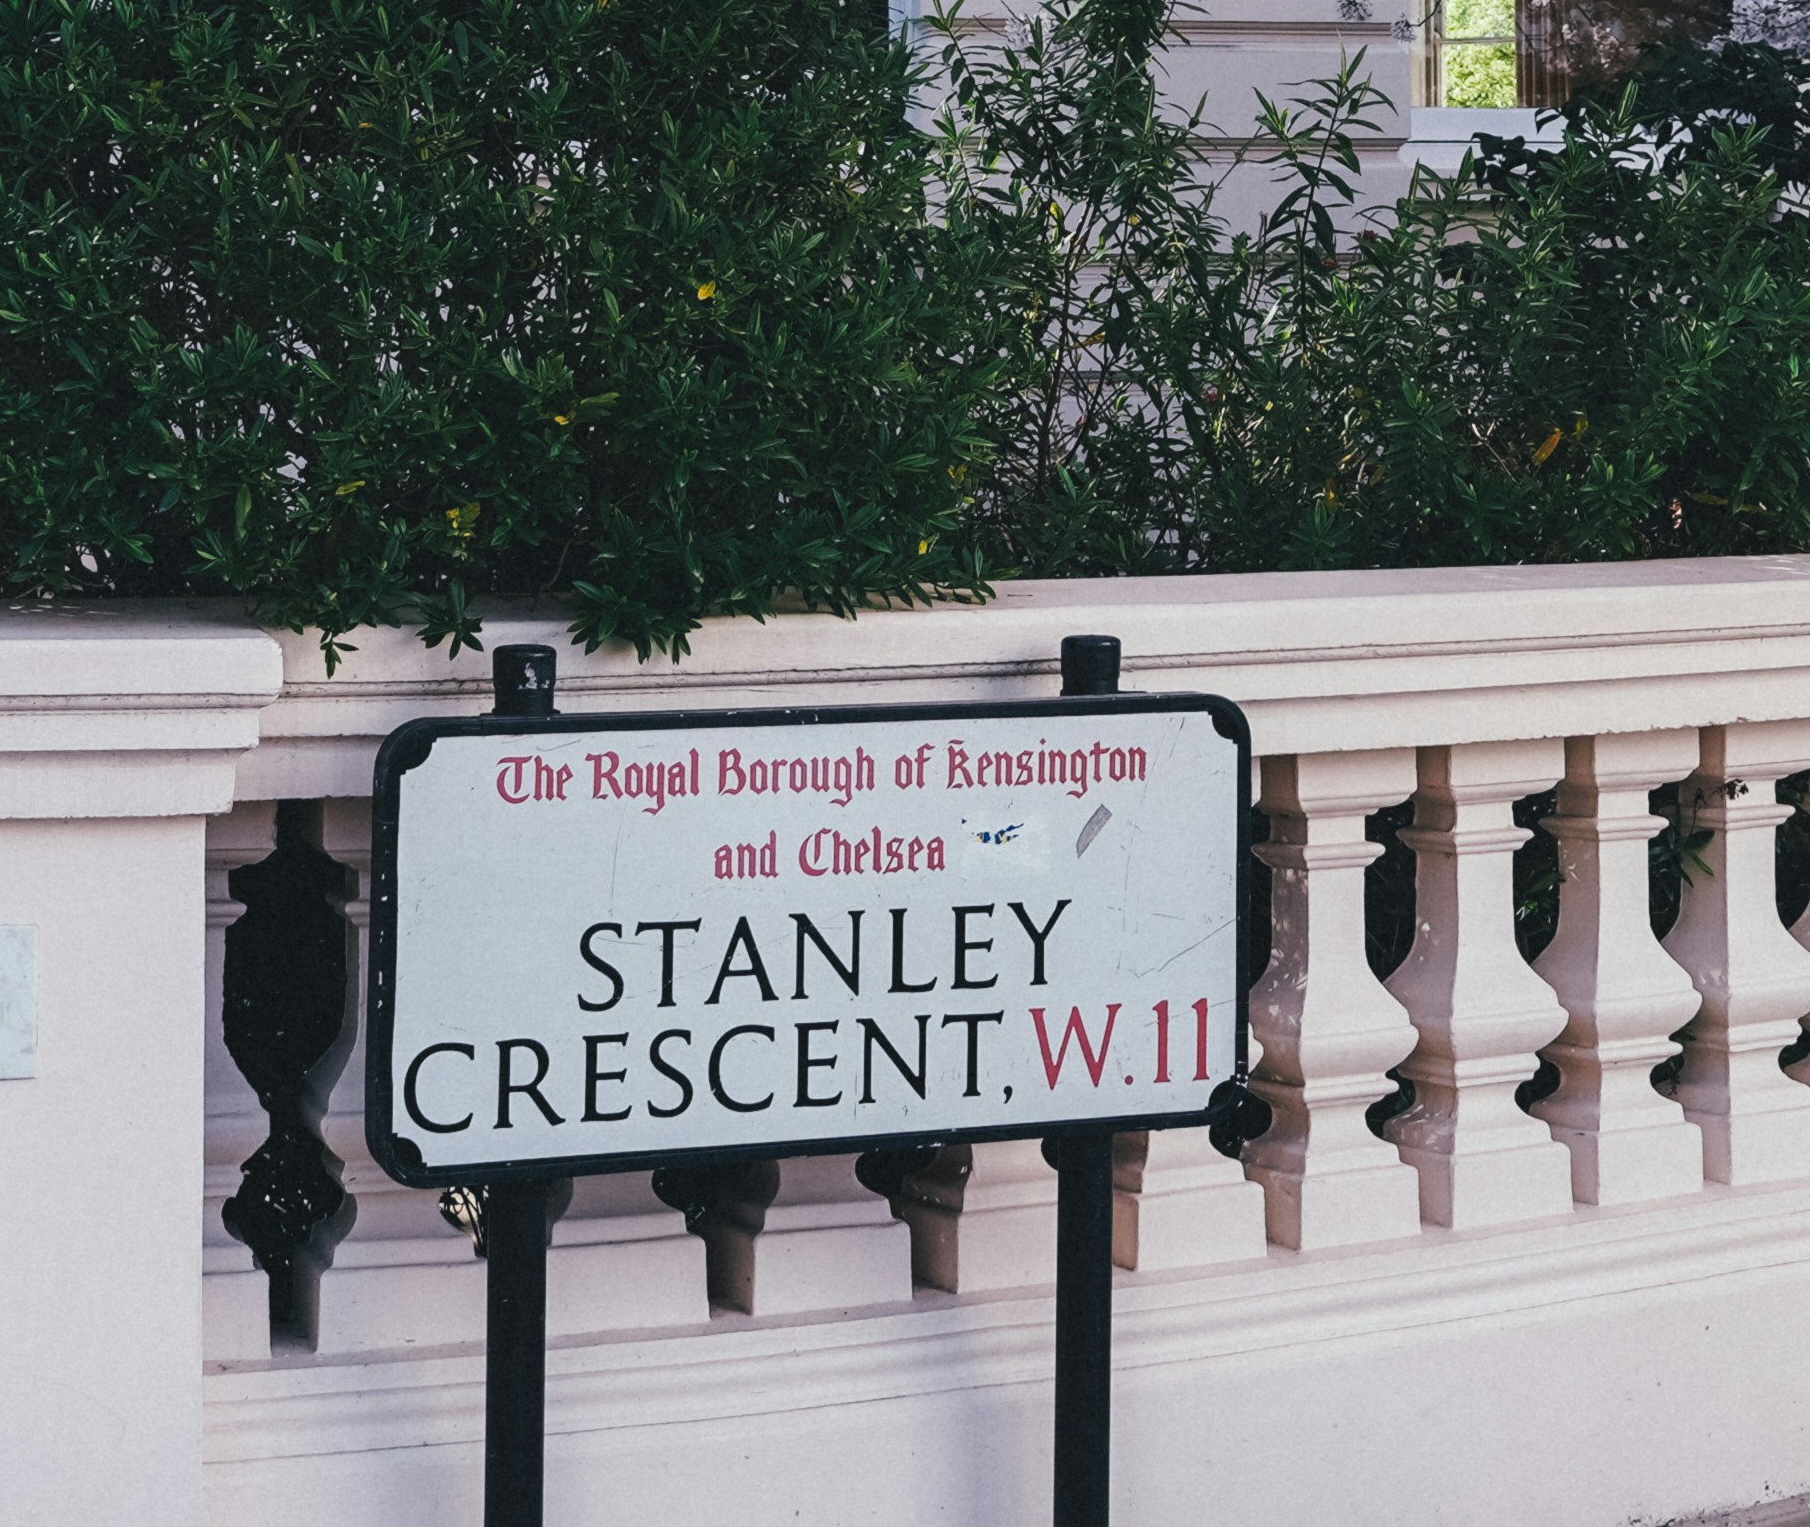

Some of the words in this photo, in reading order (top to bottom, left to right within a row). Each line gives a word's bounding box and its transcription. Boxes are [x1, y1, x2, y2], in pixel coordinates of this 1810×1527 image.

[496, 755, 574, 805] The
[585, 748, 700, 815] Royal
[718, 747, 875, 807] Borough
[894, 744, 933, 790] of
[946, 739, 1147, 798] Kensington
[714, 831, 778, 879] and
[798, 826, 945, 877] Chelsea
[577, 899, 1072, 1012] STANLEY
[403, 1009, 1014, 1134] CRESCENT,
[1029, 997, 1209, 1089] W.11
